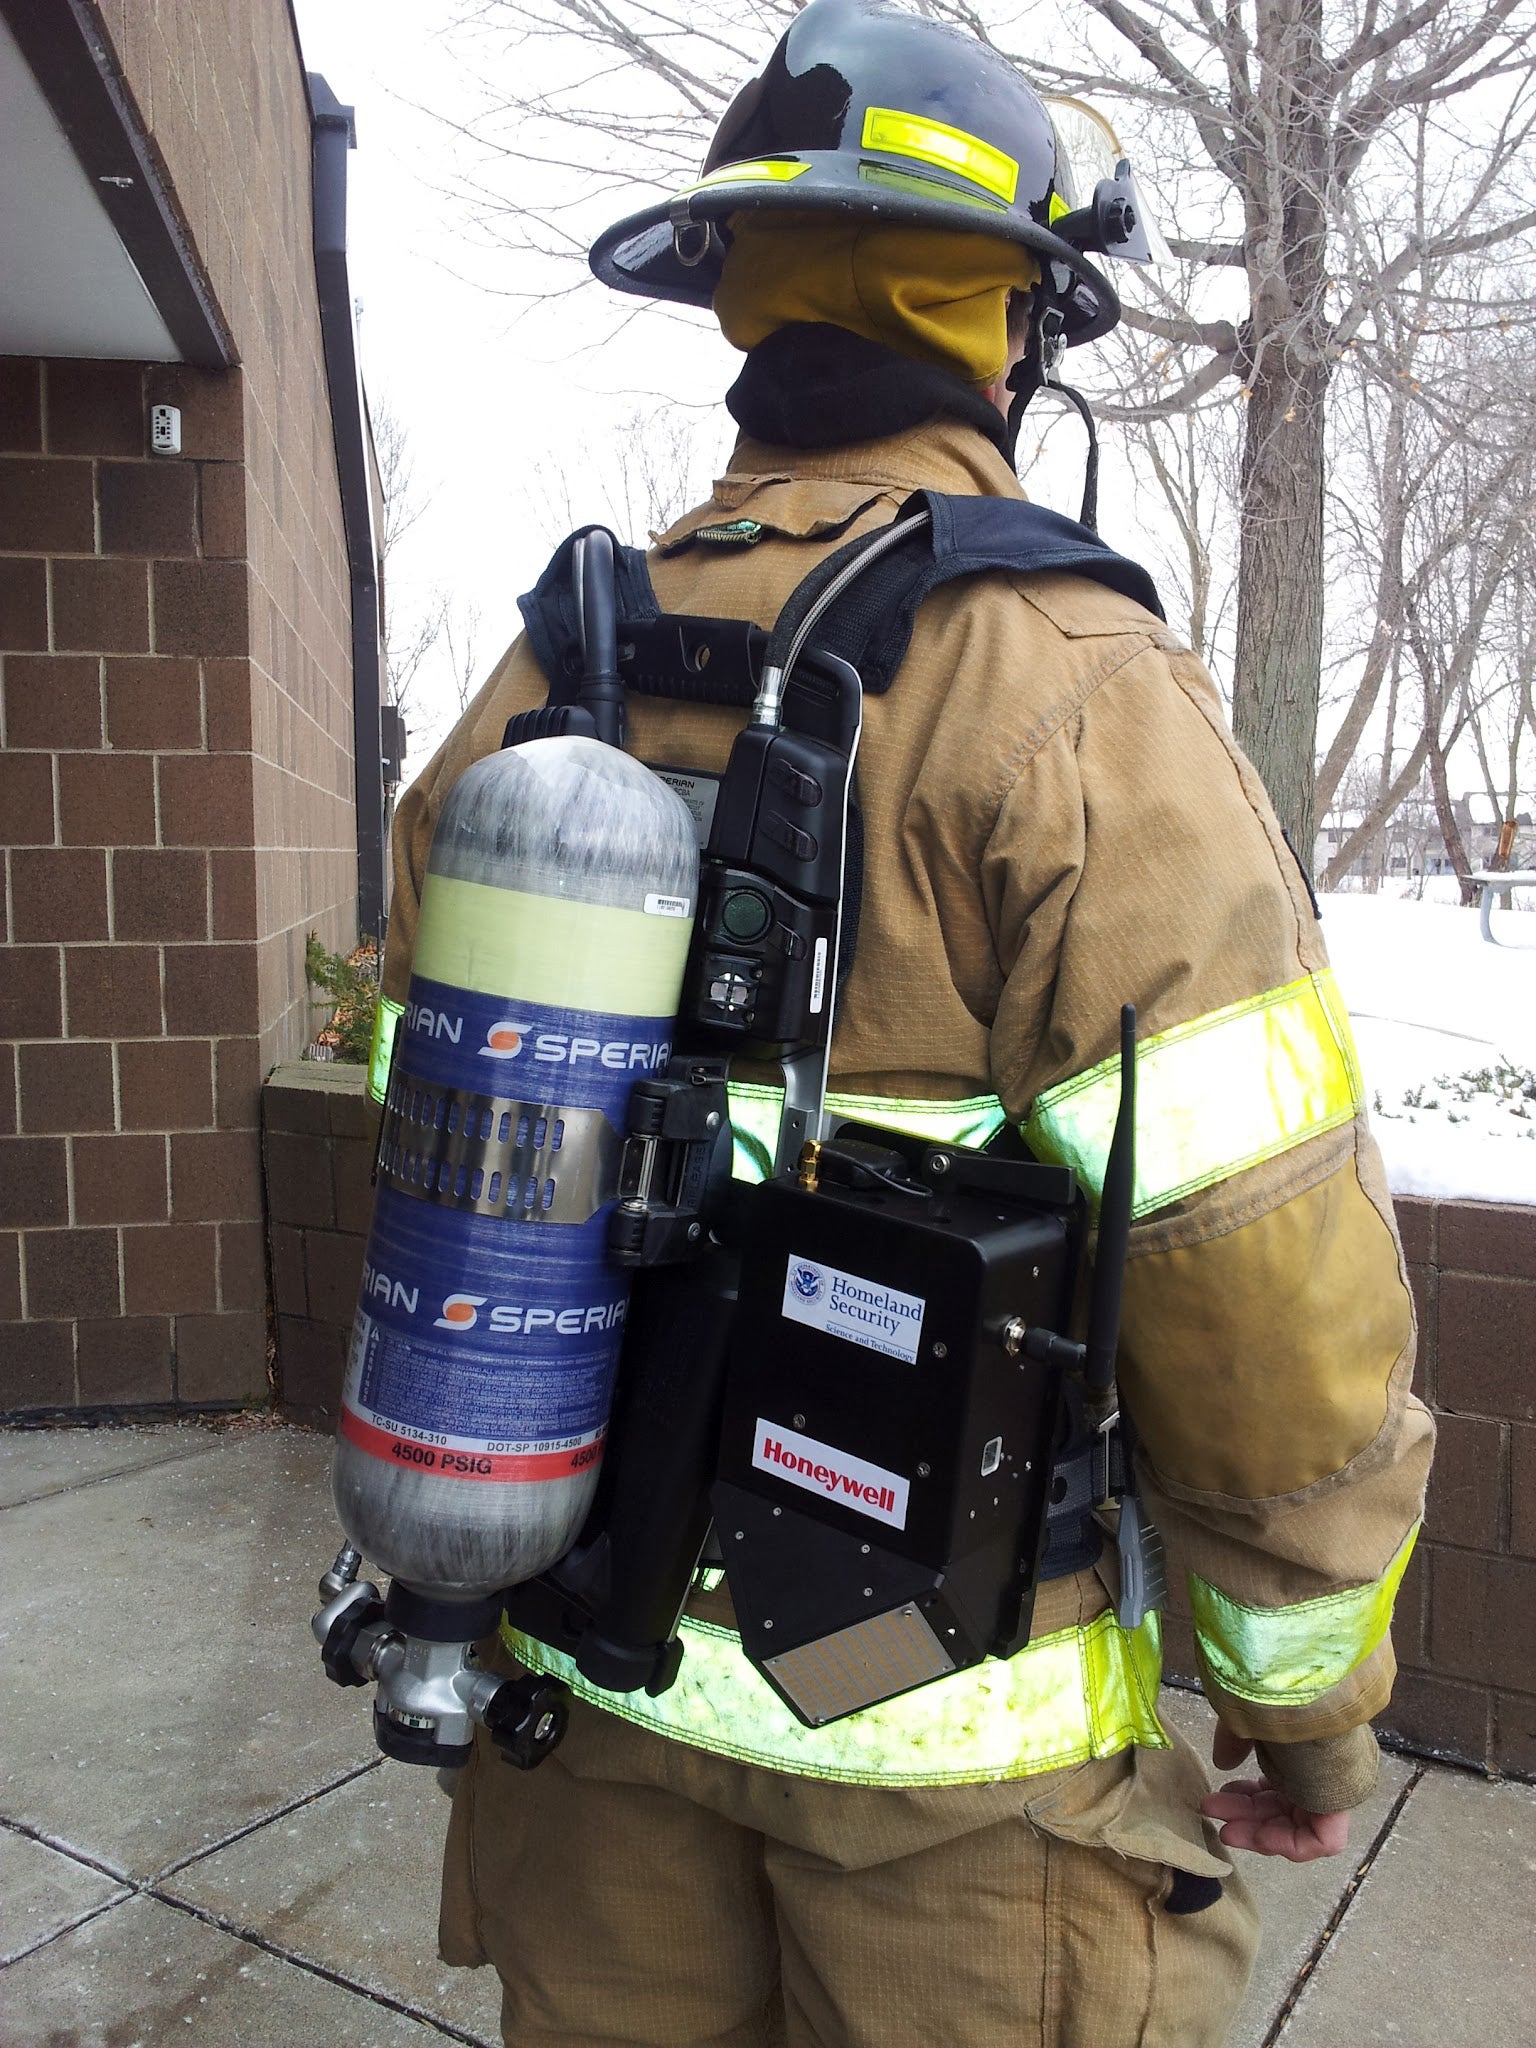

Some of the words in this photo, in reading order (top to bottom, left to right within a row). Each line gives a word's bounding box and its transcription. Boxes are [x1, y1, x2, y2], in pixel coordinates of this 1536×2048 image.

[660, 776, 695, 788] PERIAN
[489, 1294, 631, 1335] SPERIA
[829, 1295, 901, 1336] Security
[831, 1276, 923, 1322] Homeland
[825, 1323, 853, 1340] Science
[855, 1336, 869, 1346] and
[870, 1340, 914, 1363] Technology
[371, 1413, 398, 1434] TC-SU
[400, 1424, 447, 1446] 5134-310
[486, 1441, 530, 1453] DOT-SP
[533, 1437, 582, 1452] 10915-4500
[391, 1441, 435, 1468] 4500
[440, 1453, 493, 1476] PSIG
[763, 1437, 895, 1513] Honeywell
